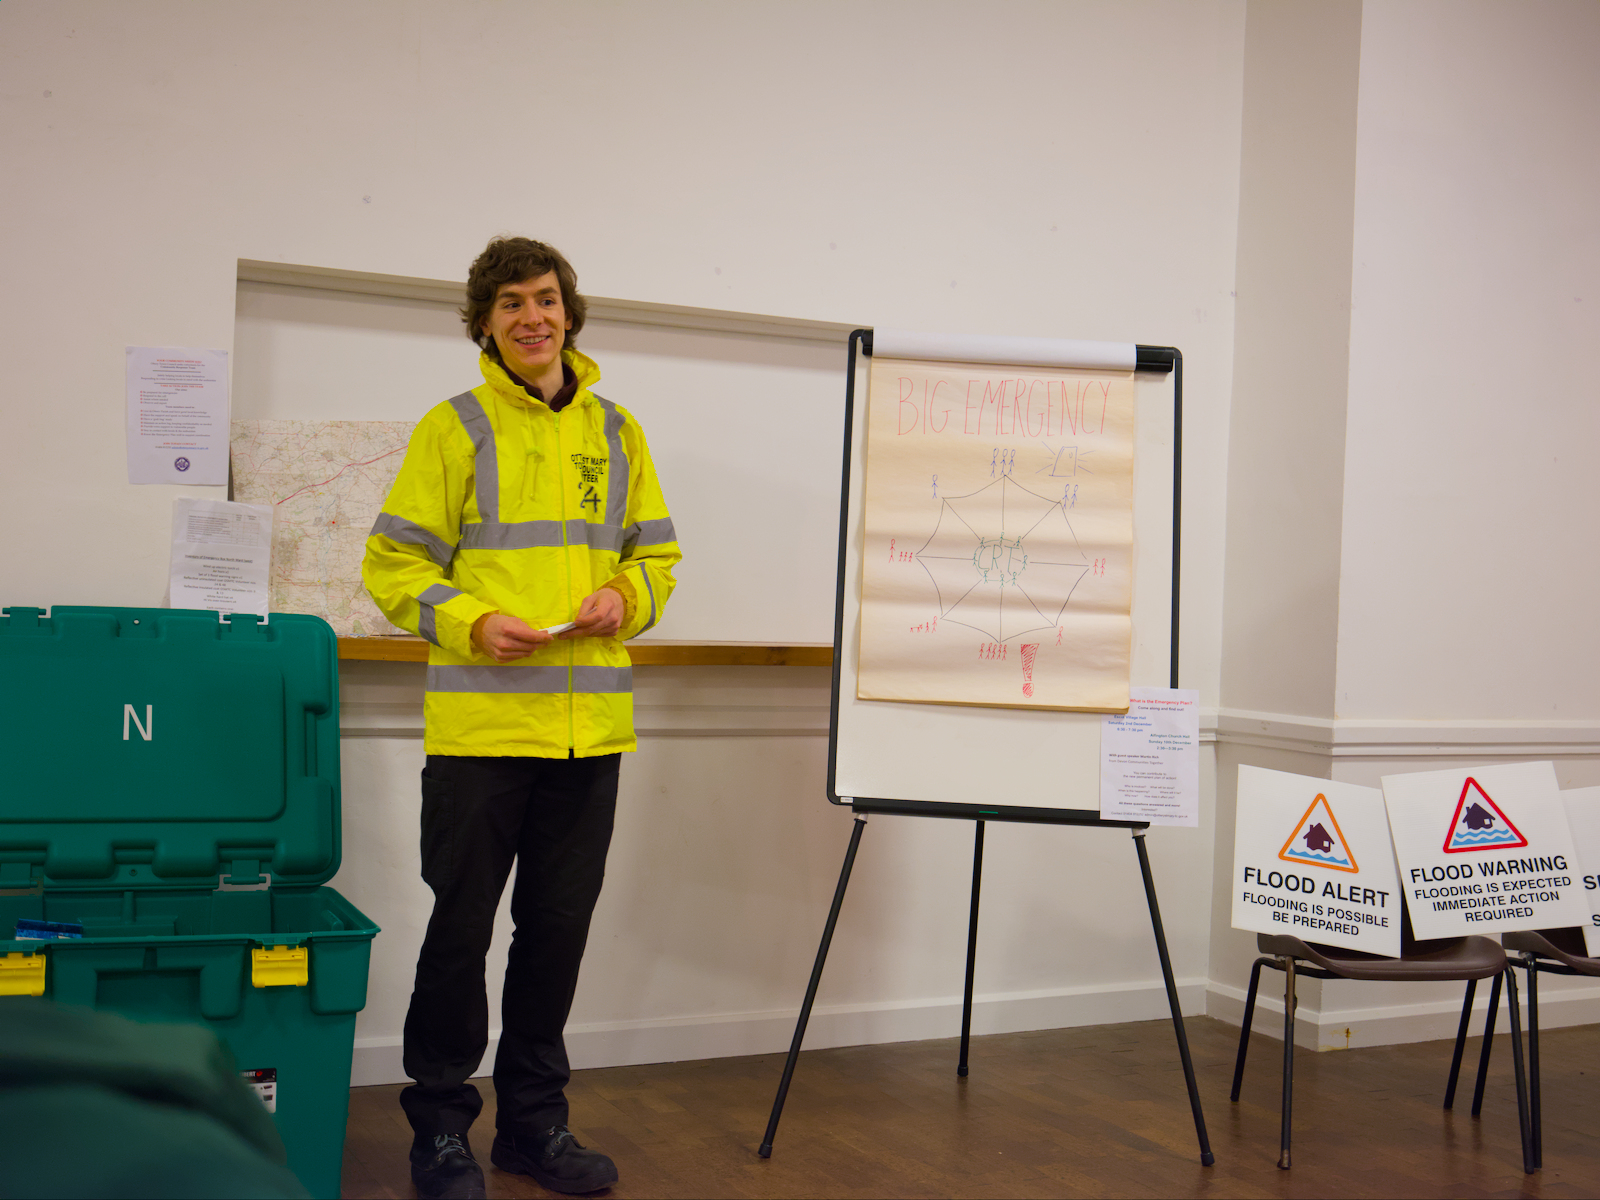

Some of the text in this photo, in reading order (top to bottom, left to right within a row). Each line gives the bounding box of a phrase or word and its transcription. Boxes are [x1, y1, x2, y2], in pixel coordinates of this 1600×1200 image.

[898, 377, 1111, 437] BIG EMERGENCY
[582, 466, 604, 475] OUNCIL
[582, 474, 598, 483] TEER
[123, 704, 152, 741] N
[1410, 855, 1568, 883] FLOOD WARNING
[1244, 867, 1390, 908] FLOOD ALERT
[1414, 876, 1571, 899] FLOODING IS EXPECTED
[1243, 892, 1389, 927] FLOODING IS POSSIBLE
[1433, 891, 1560, 911] IMMEDIATE ACTION
[1272, 911, 1359, 936] BE PREPARED
[1465, 907, 1534, 922] REQUIRED
